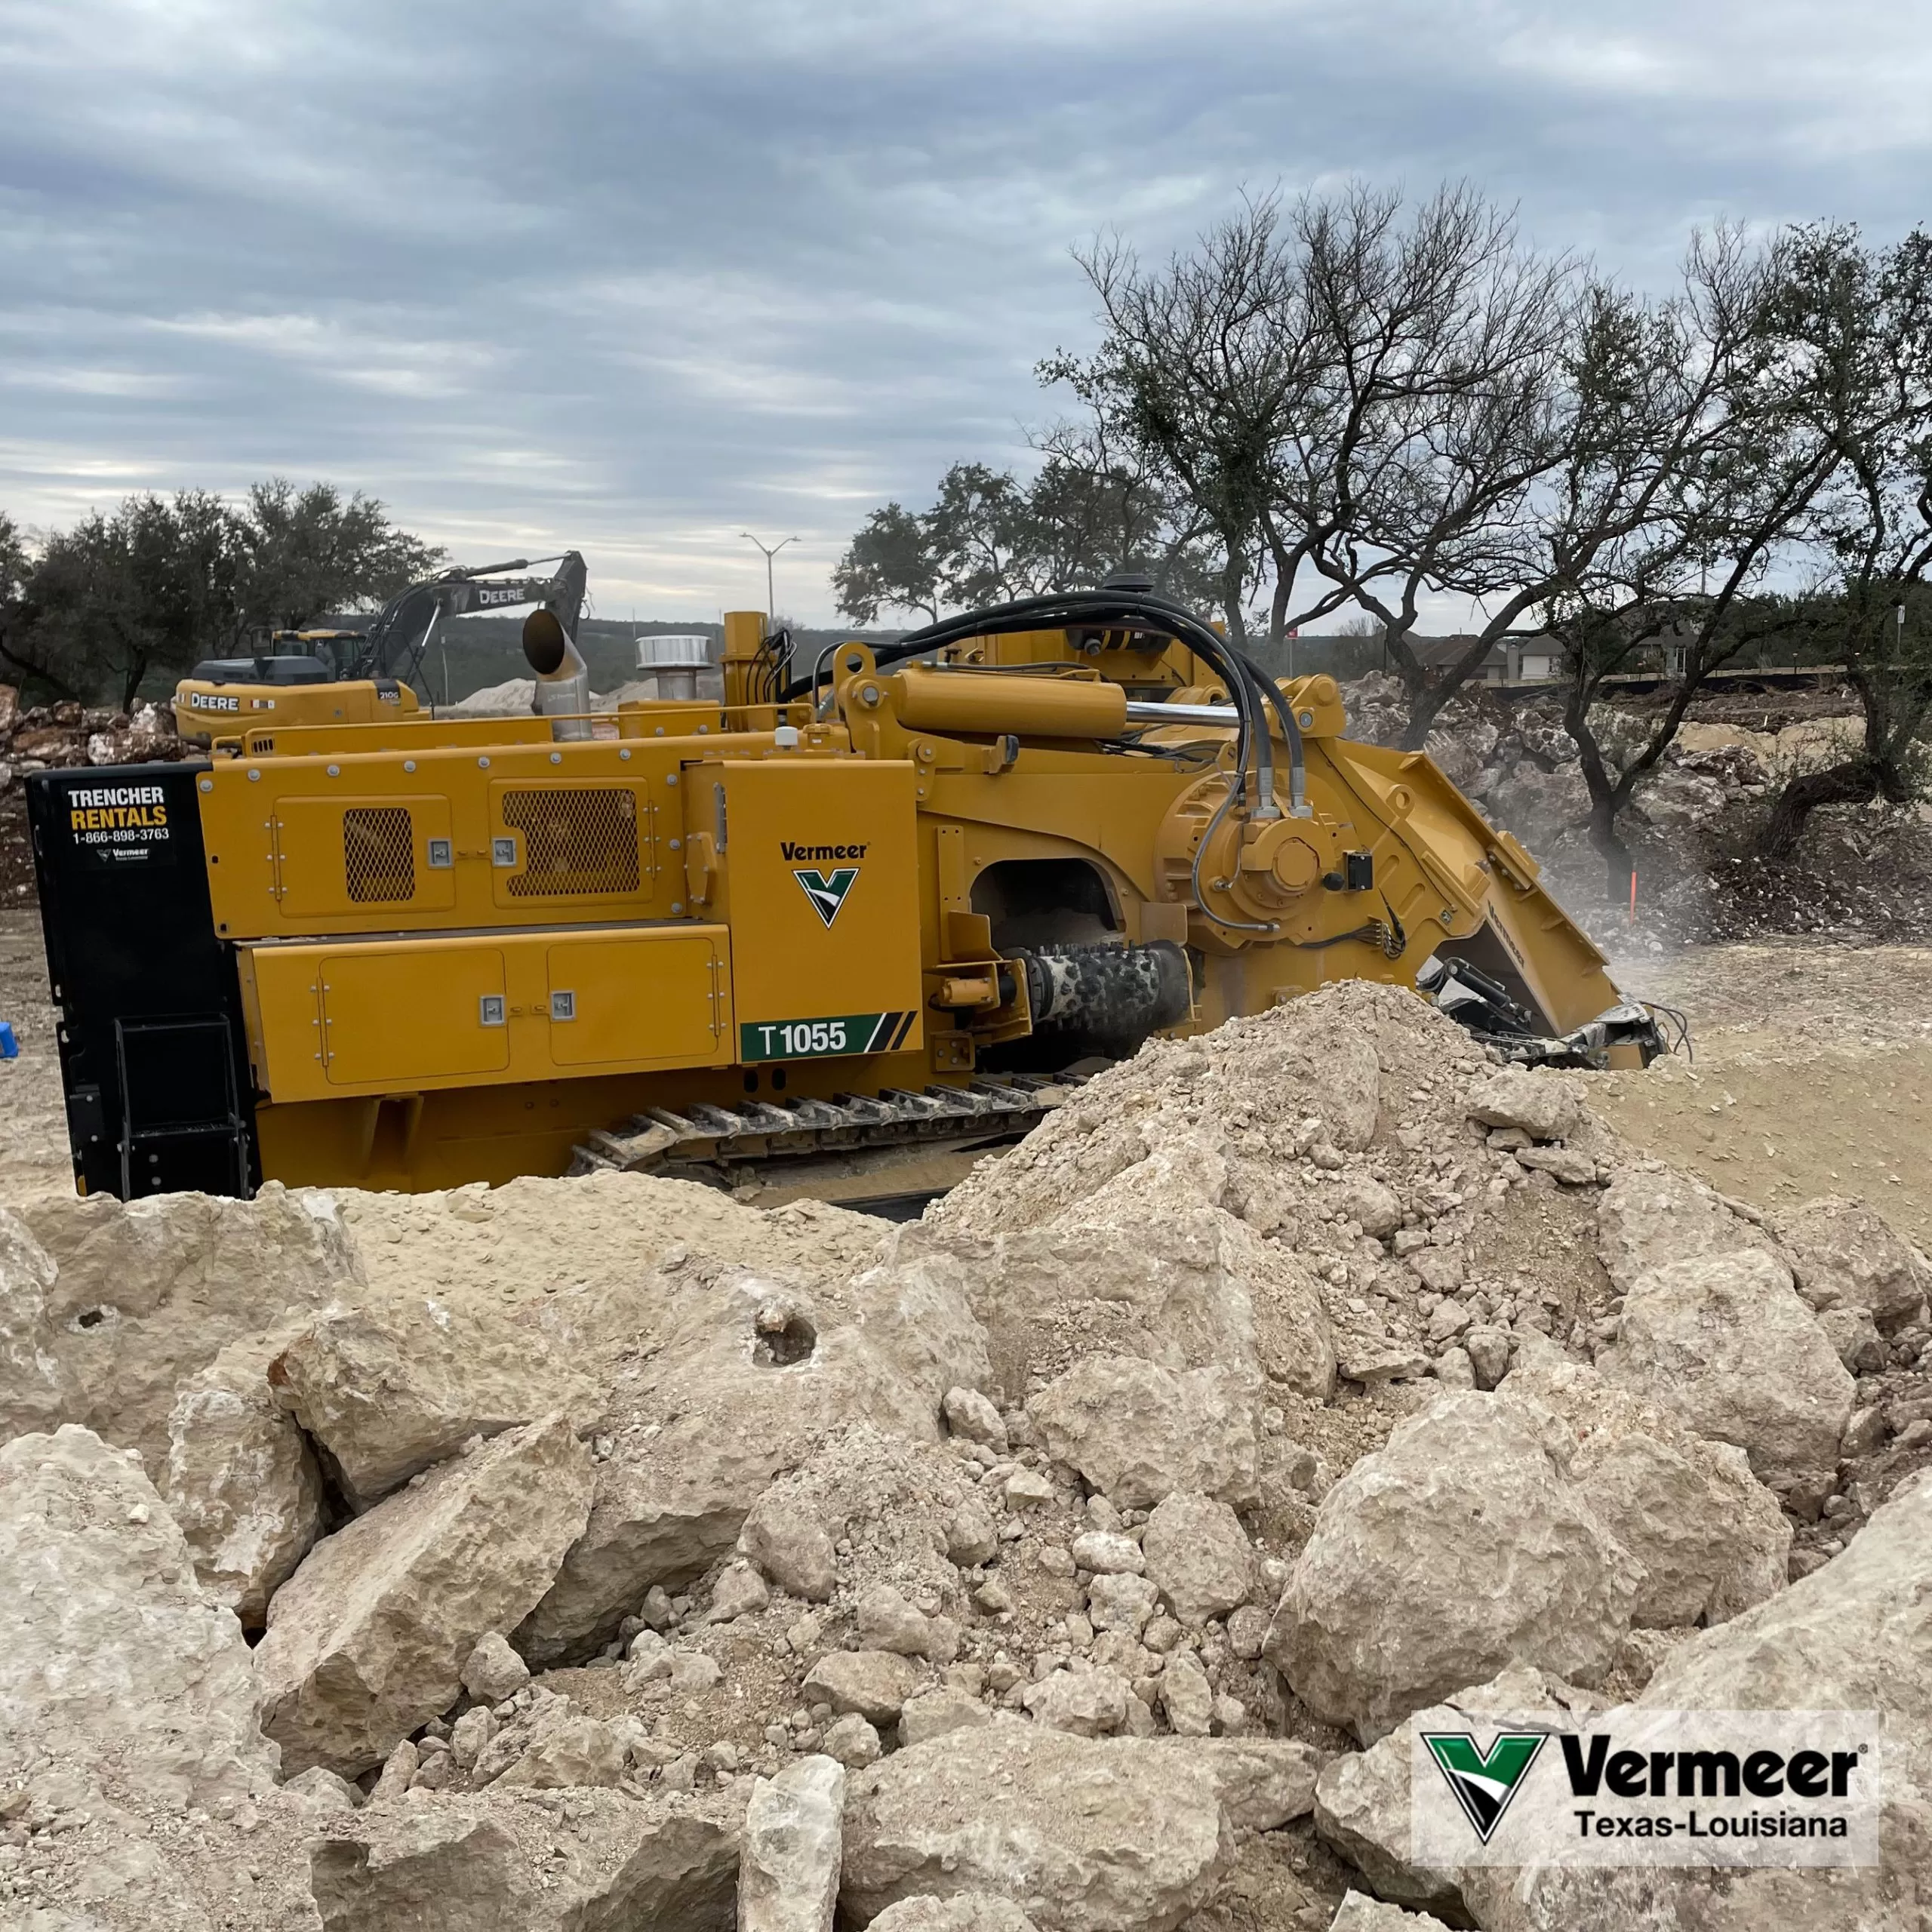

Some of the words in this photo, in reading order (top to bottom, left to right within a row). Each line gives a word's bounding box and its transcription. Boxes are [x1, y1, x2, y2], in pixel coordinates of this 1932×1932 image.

[479, 588, 525, 605] DEERE
[191, 692, 238, 711] DEERE
[68, 786, 164, 808] TRENCHER
[70, 805, 168, 831] RENTALS
[72, 827, 170, 844] 1-866-898-3763
[112, 848, 149, 857] Vermeer
[780, 842, 867, 861] Vermeer
[1487, 899, 1525, 969] Vermeer
